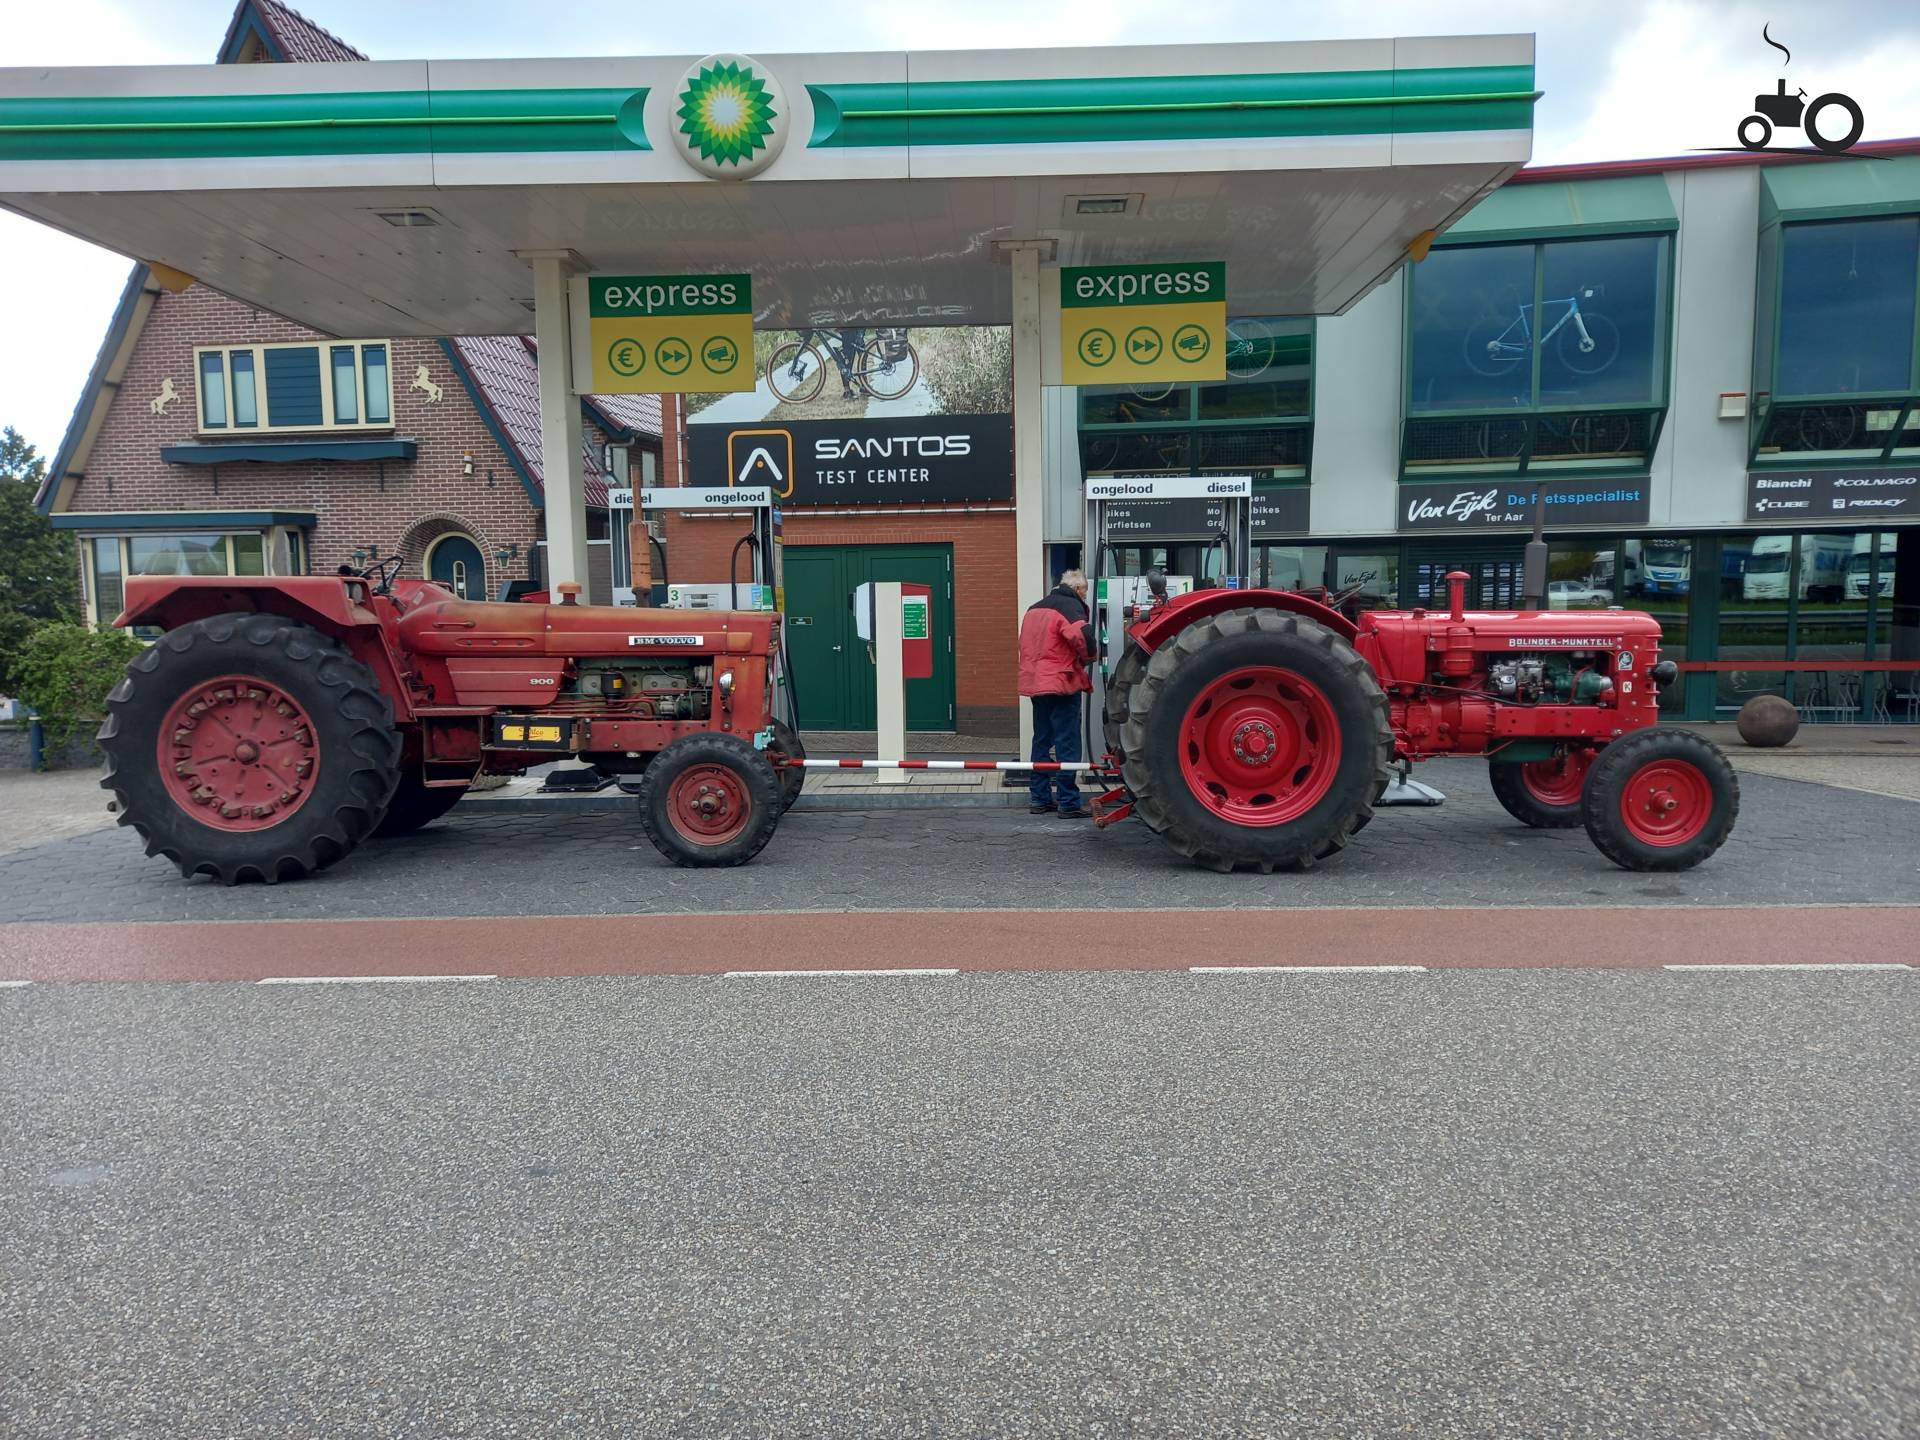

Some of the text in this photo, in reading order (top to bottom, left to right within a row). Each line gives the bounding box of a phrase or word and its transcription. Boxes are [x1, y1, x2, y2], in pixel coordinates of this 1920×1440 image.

[1076, 271, 1210, 302] express
[604, 280, 738, 313] express
[815, 434, 971, 460] SANTOS
[815, 468, 930, 485] TEST CENTER
[1842, 477, 1917, 487] COLNAGO
[1207, 482, 1246, 493] diesel
[1756, 478, 1812, 489] Bianchi
[1092, 483, 1153, 497] ongelood
[614, 494, 652, 504] dieel
[704, 491, 765, 505] ongelood
[1507, 490, 1641, 506] De Fetsspecialist
[1849, 498, 1907, 507] RIDLEY
[1408, 498, 1444, 522] Van
[1767, 500, 1810, 509] CUBE
[1485, 513, 1523, 522] Ter Aar
[1182, 581, 1189, 592] 1
[671, 589, 679, 601] 3
[1509, 638, 1613, 647] BOLINDER-MUNKTELL
